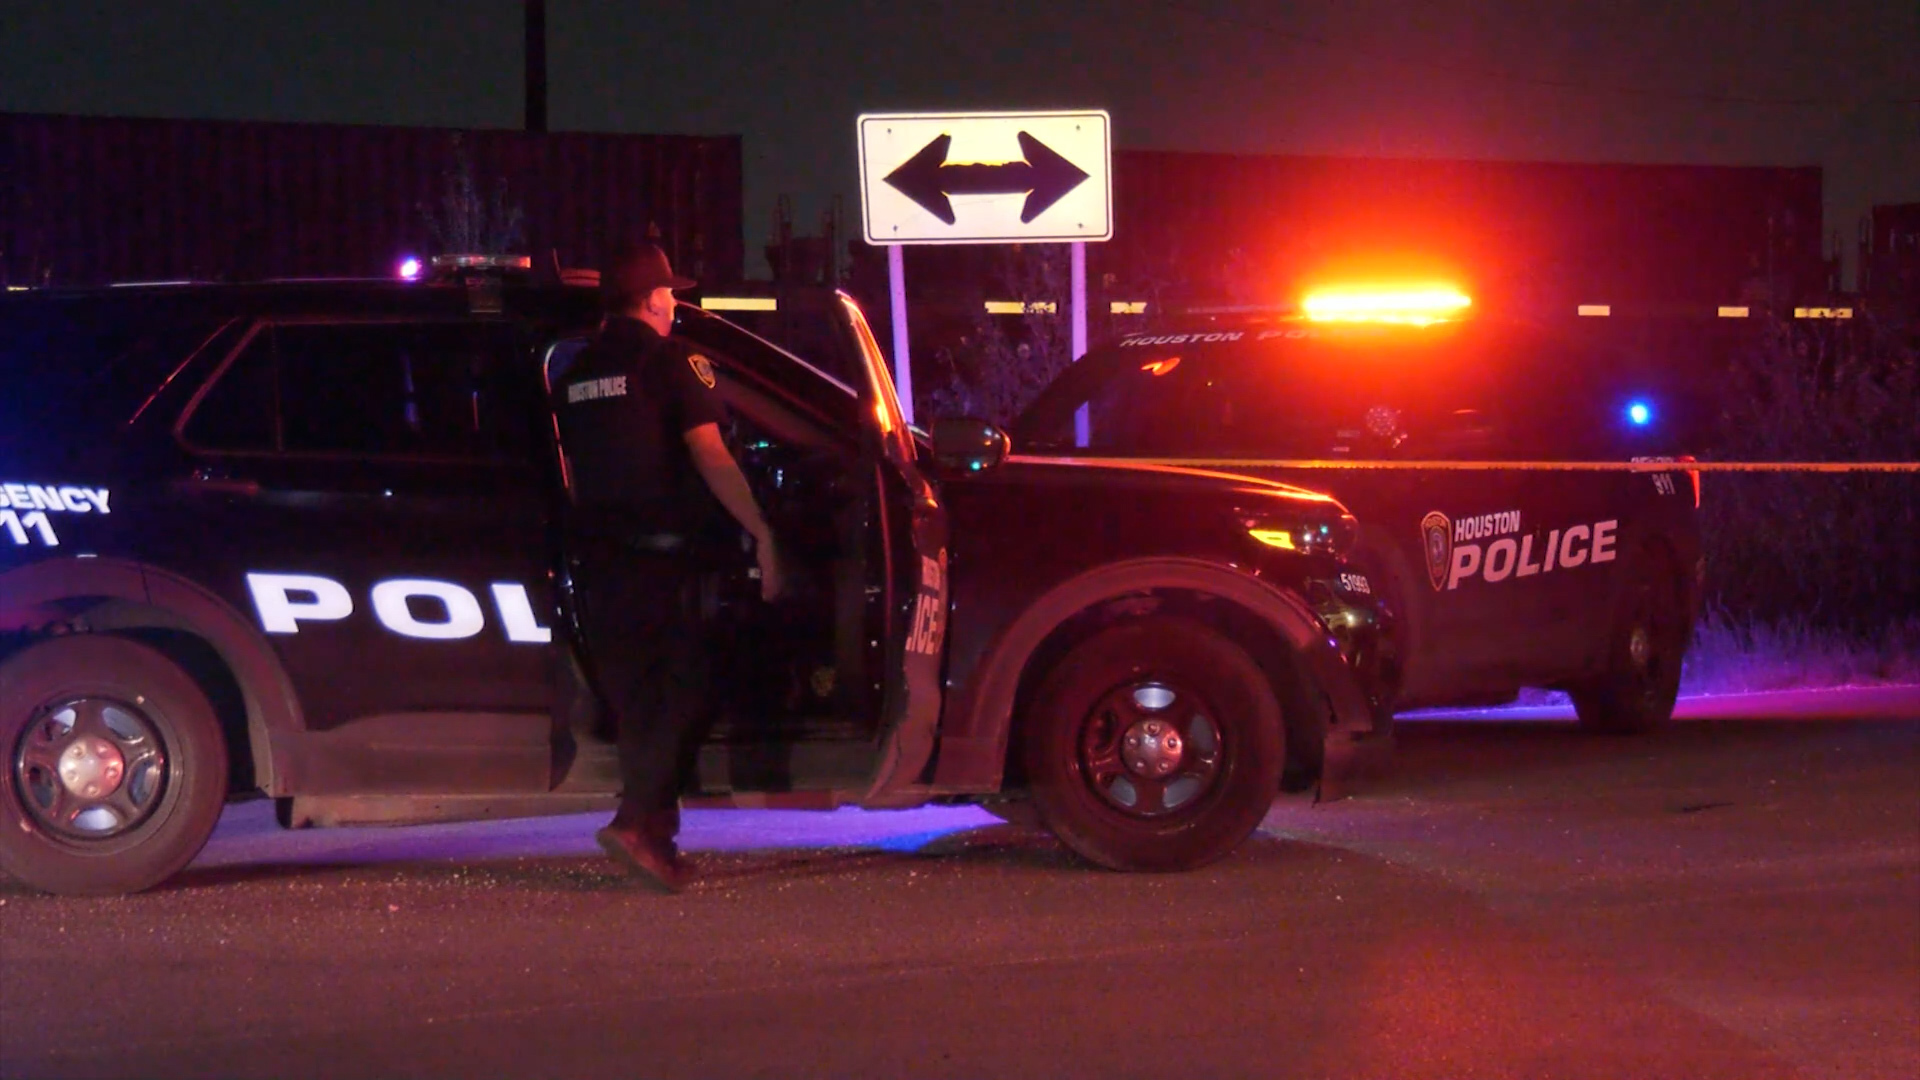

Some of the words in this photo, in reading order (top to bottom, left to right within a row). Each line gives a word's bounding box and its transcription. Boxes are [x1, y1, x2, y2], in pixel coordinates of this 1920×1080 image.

[1119, 331, 1245, 347] HOUSTON
[599, 376, 627, 397] POLICE
[1651, 473, 1676, 495] 911
[1454, 510, 1520, 542] HOUSTON
[1447, 519, 1618, 590] POLICE
[246, 572, 552, 642] POL
